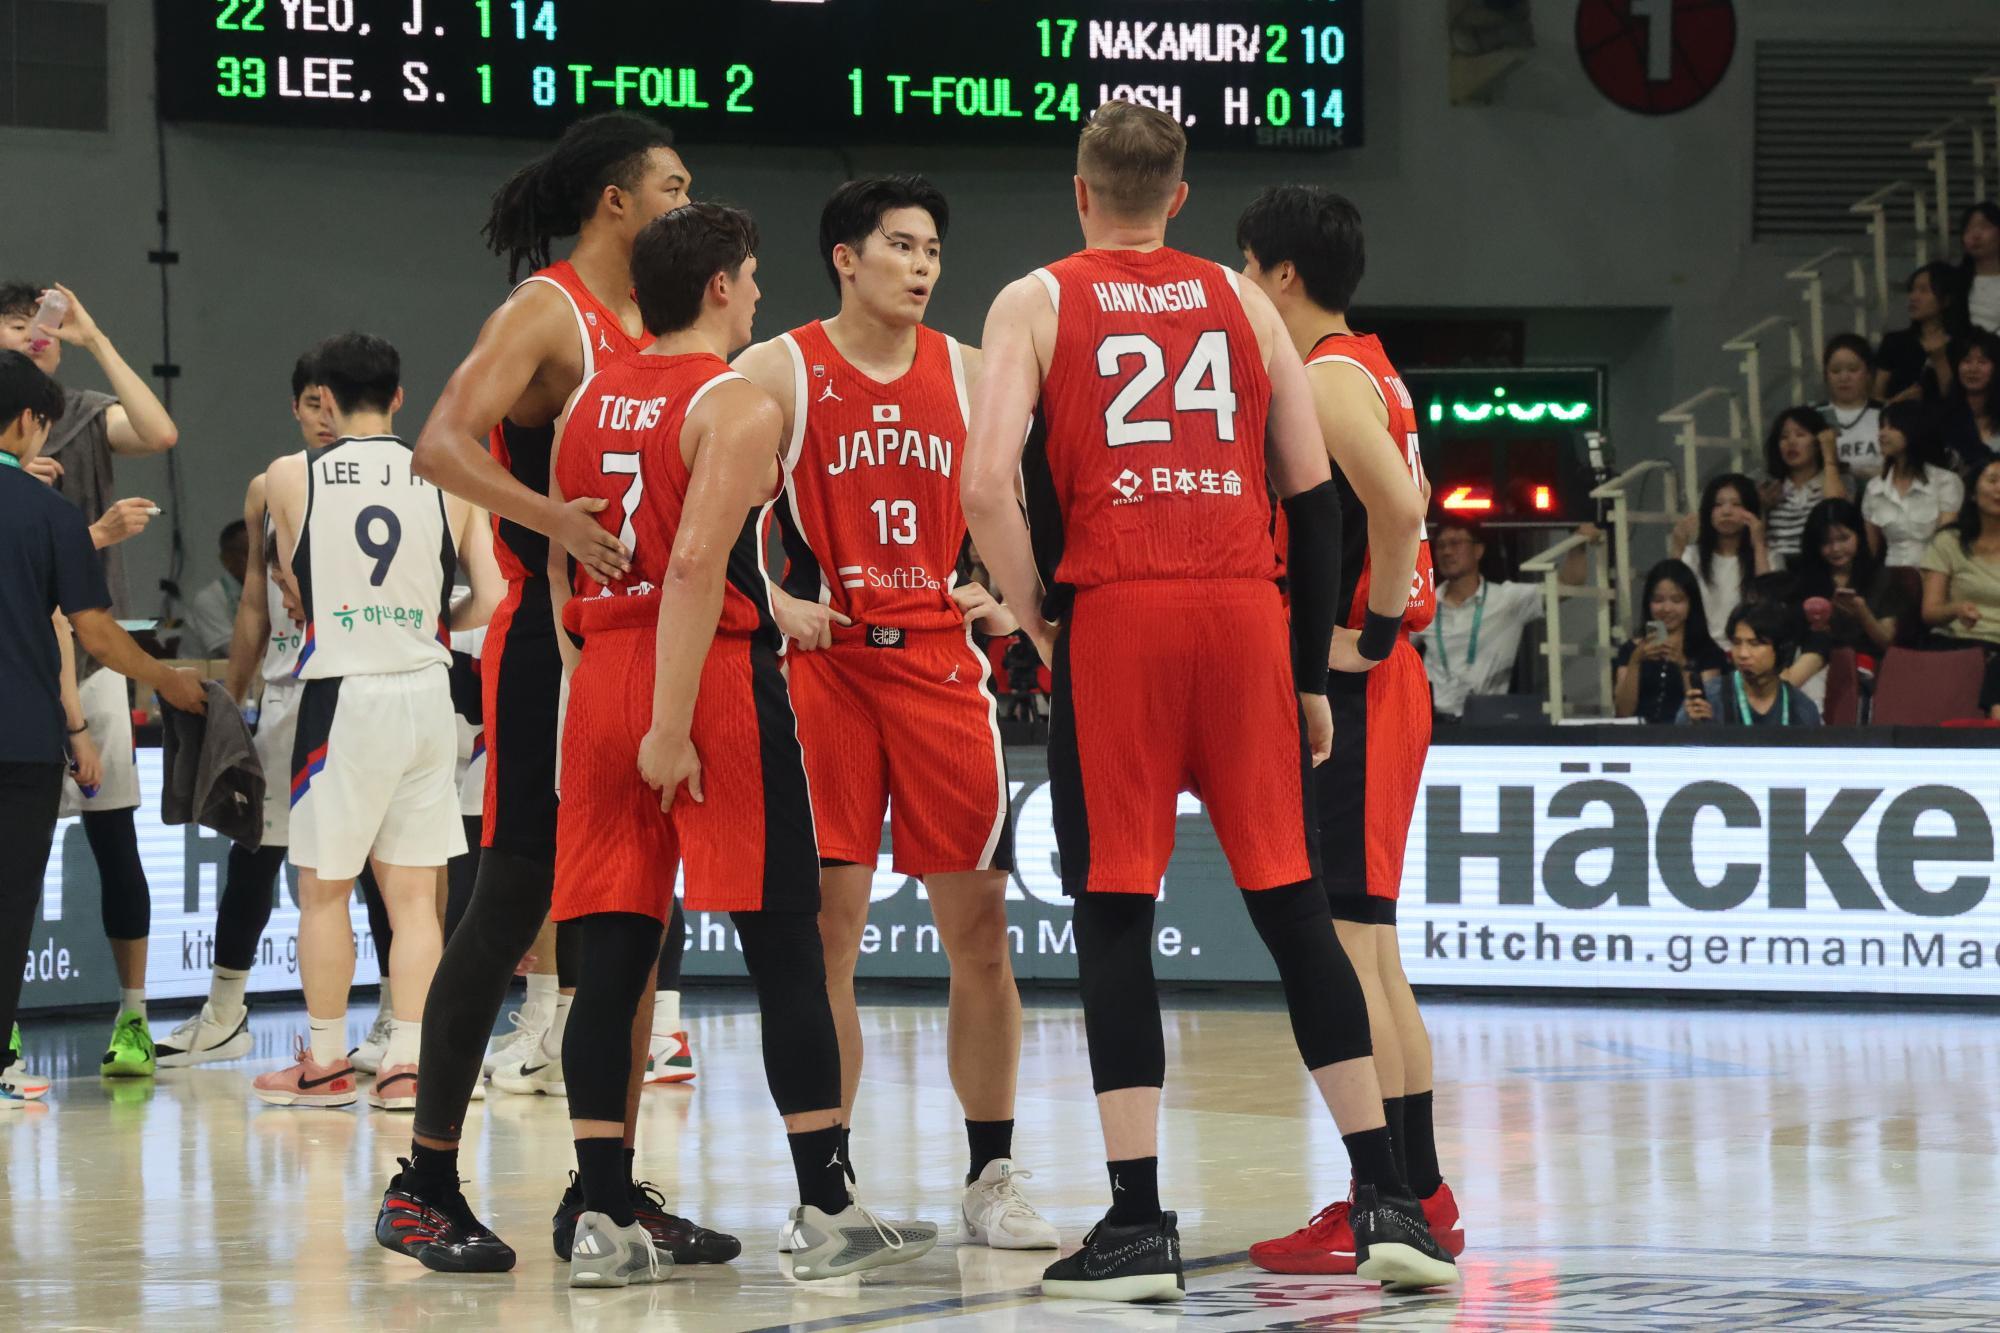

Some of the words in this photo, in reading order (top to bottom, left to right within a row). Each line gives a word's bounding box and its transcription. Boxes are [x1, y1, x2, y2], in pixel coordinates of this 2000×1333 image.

[216, 0, 264, 31] 22
[475, 0, 490, 38] 1
[511, 0, 557, 40] 14
[1036, 19, 1077, 58] 17
[1266, 25, 1288, 63] 2
[1301, 26, 1345, 64] 10
[217, 57, 266, 97] 33
[278, 56, 371, 102] LEE,
[403, 62, 445, 102] S.
[476, 65, 491, 103] 1
[533, 66, 555, 106] 8
[567, 64, 709, 108] T-FOUL
[726, 64, 754, 112] 2
[848, 68, 862, 116] 1
[887, 75, 1023, 117] T-FOUL
[1034, 83, 1080, 122] 24
[1224, 87, 1262, 126] H.
[1266, 88, 1291, 126] 0
[1301, 89, 1345, 127] 14
[1093, 279, 1208, 313] HAWKINSON
[1096, 329, 1238, 448] 24
[828, 428, 952, 479] JAPAN
[1839, 441, 1878, 457] REA
[323, 462, 360, 485] LEE
[380, 464, 391, 486] J
[1151, 467, 1242, 497] 日本生命
[601, 451, 643, 562] 7
[870, 499, 917, 545] 13
[355, 505, 402, 587] 9
[867, 566, 948, 591] SoftBa
[1424, 920, 2000, 972] kitchen.germanMa
